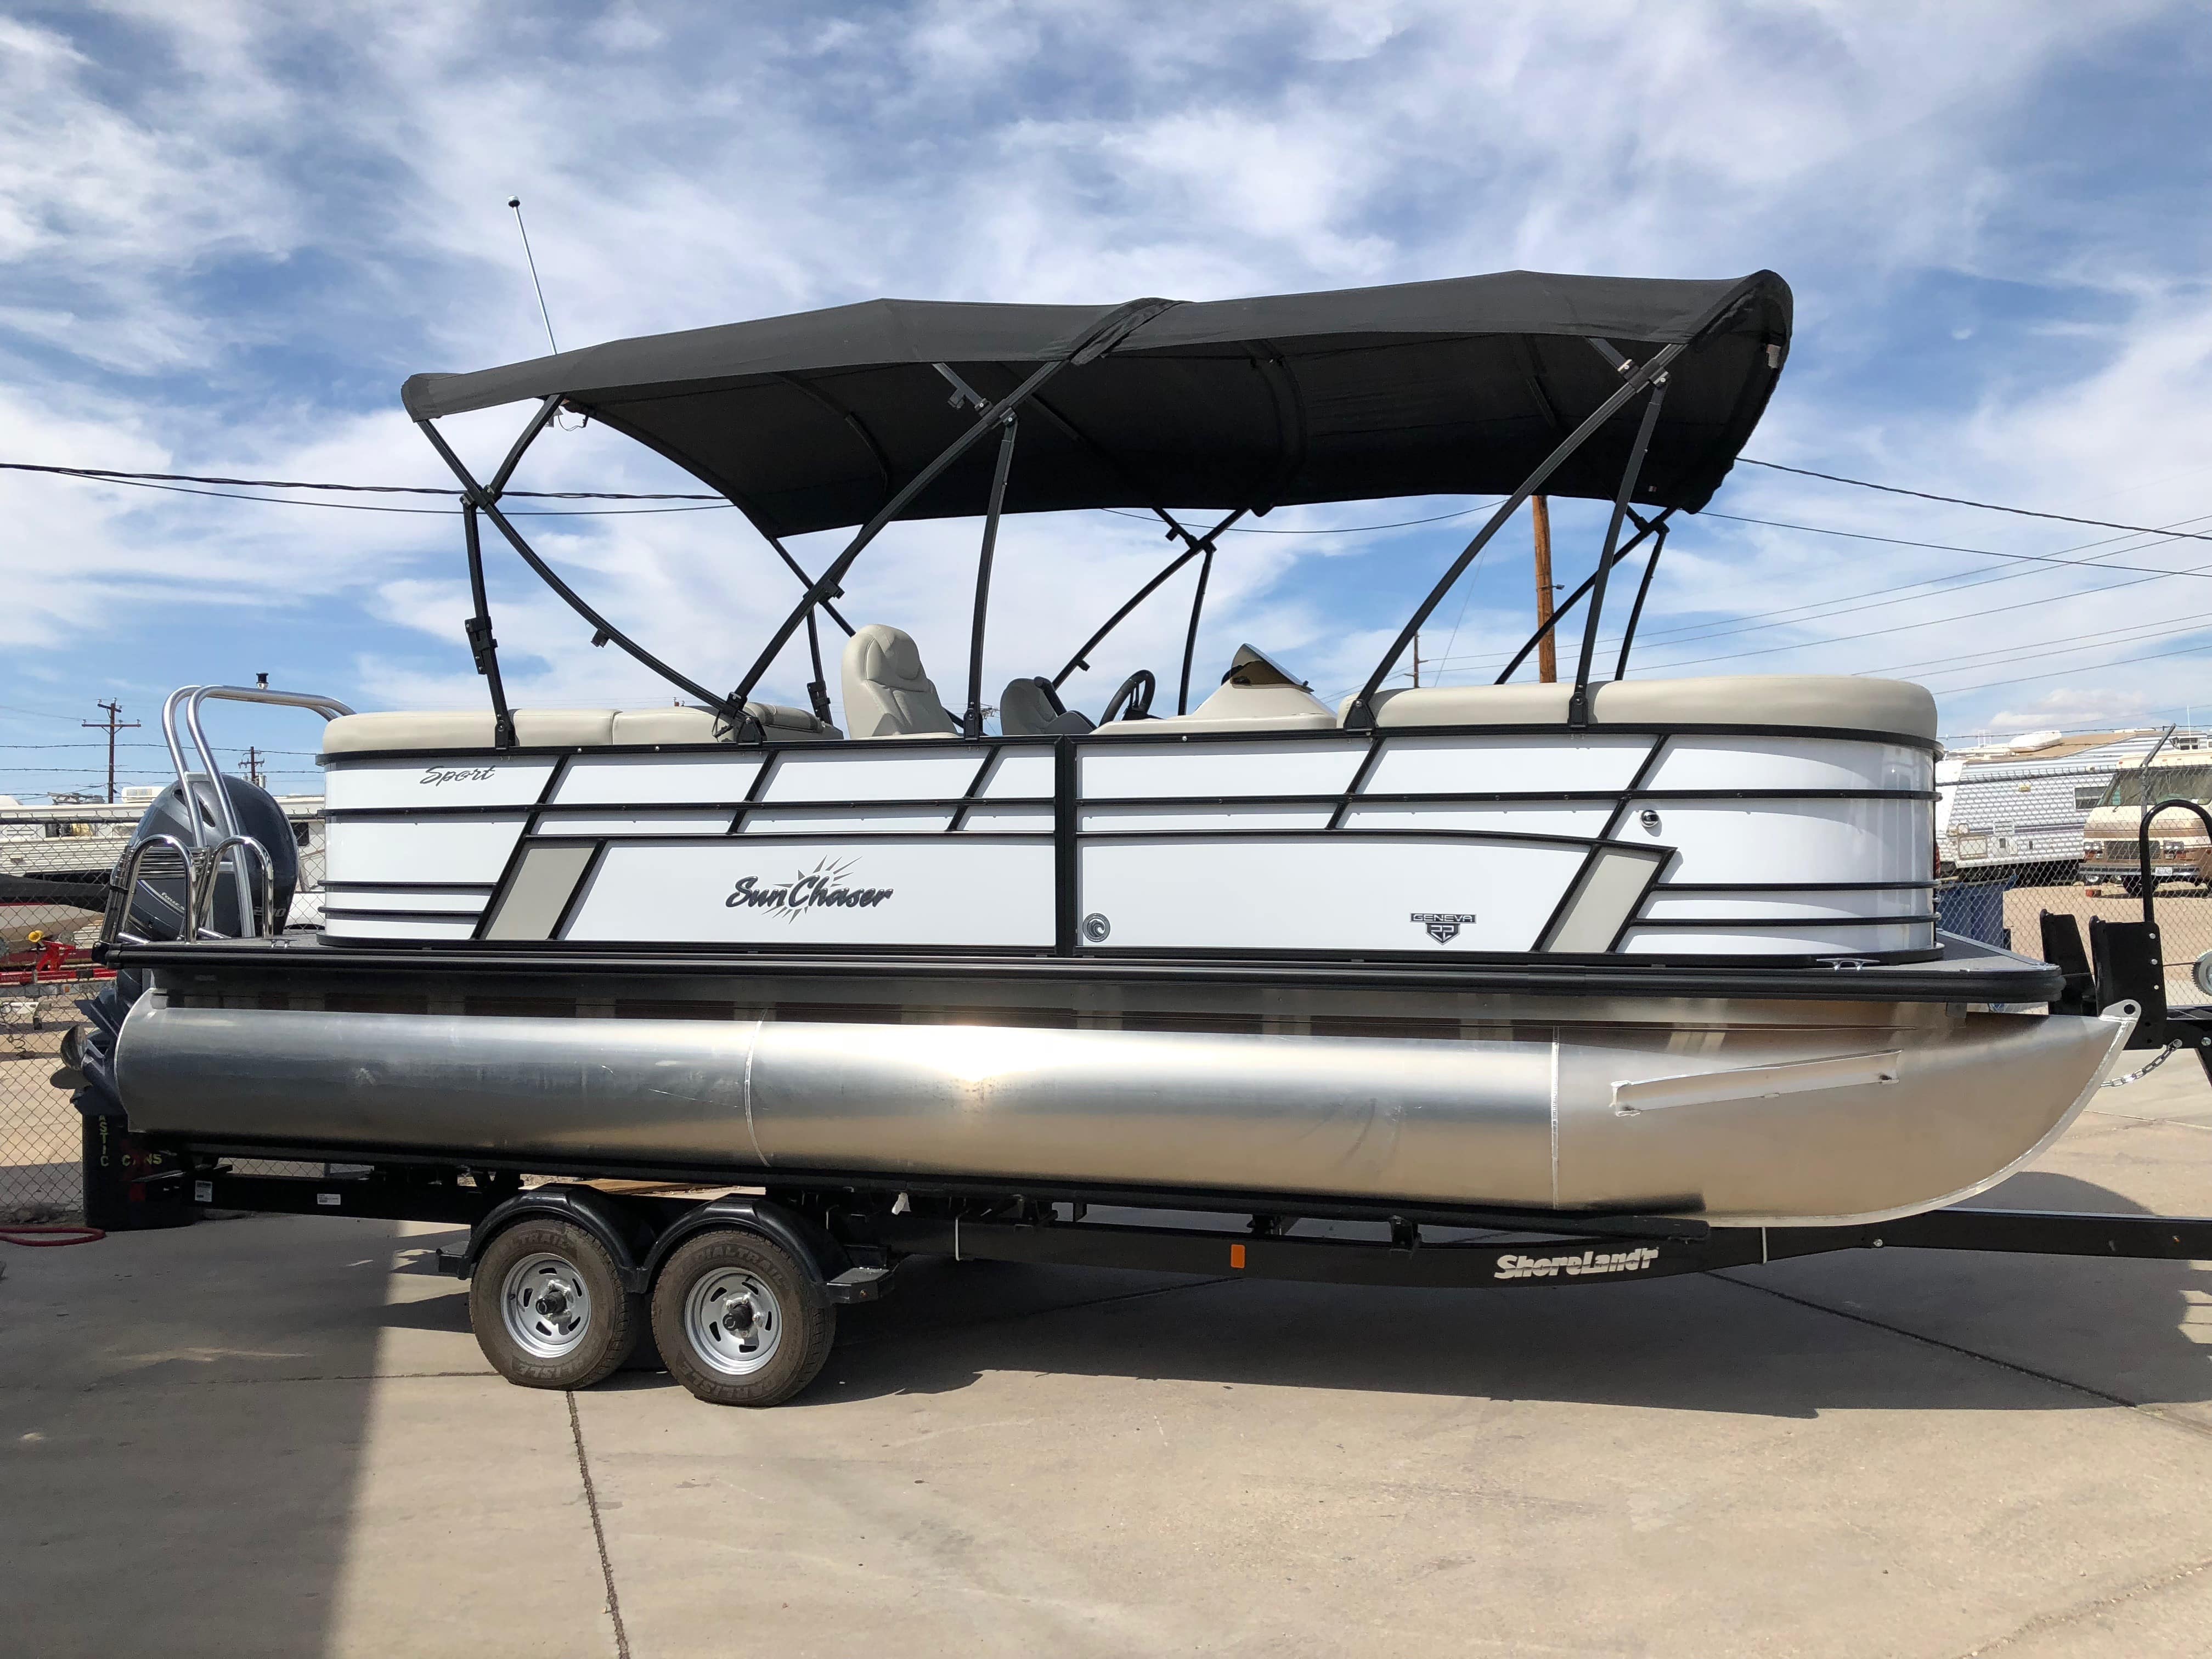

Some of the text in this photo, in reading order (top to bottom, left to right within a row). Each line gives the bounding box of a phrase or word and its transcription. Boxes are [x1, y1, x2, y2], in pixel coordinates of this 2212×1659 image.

[420, 765, 495, 787] Sport
[1413, 913, 1473, 922] GENEVA
[122, 1153, 162, 1166] CNS
